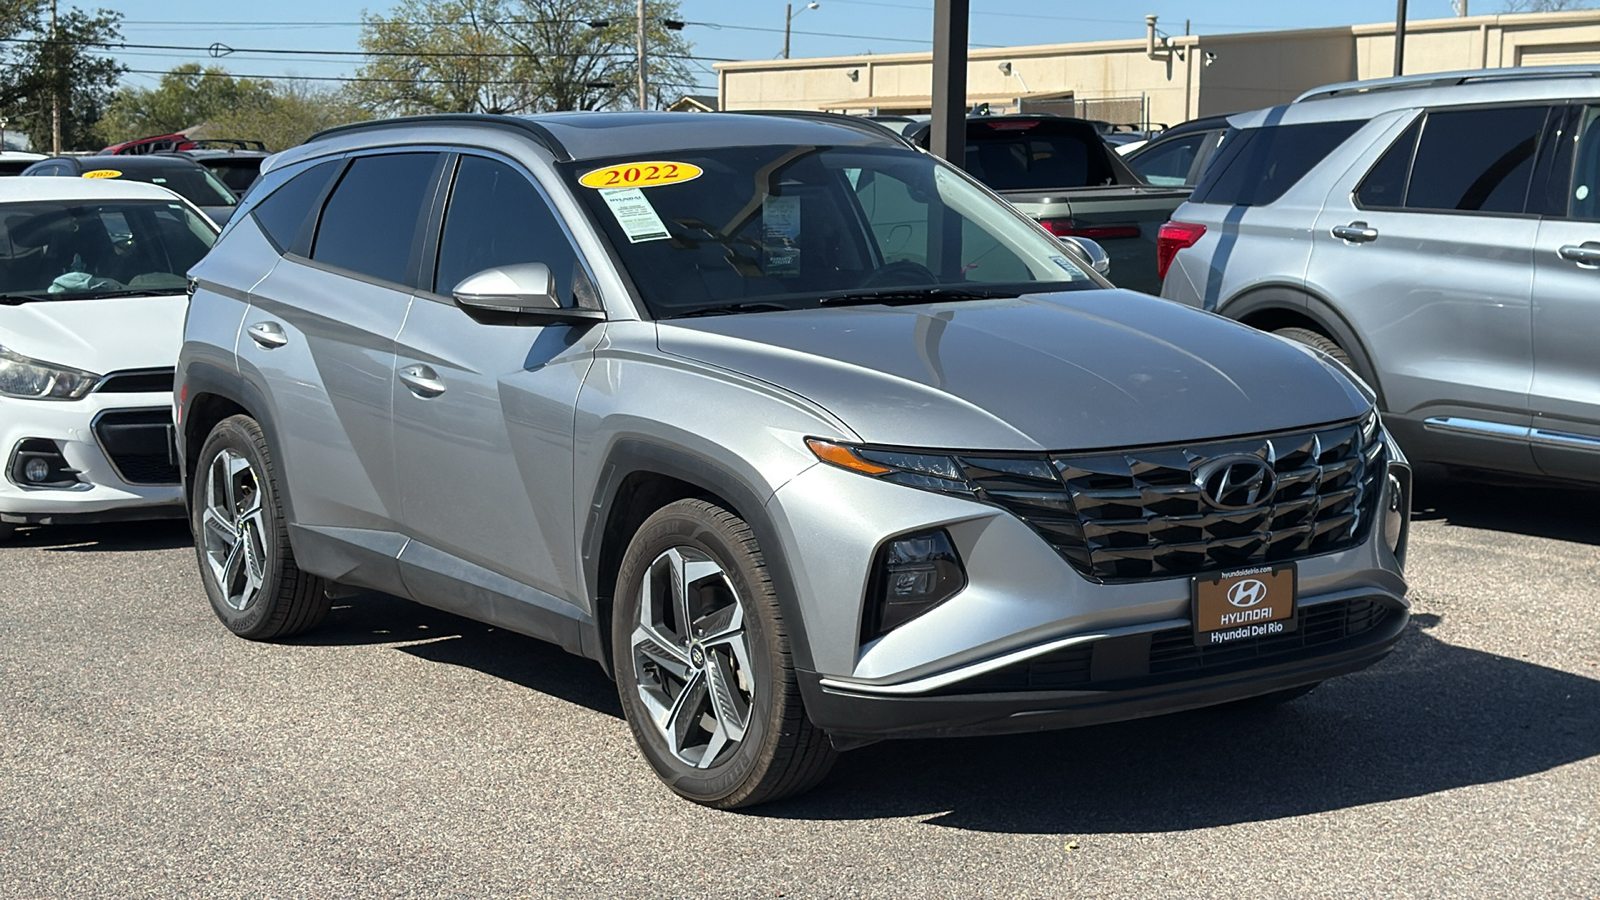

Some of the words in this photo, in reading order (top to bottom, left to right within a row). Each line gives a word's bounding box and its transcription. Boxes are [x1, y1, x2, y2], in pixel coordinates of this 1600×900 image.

[90, 171, 115, 179] 2026
[604, 164, 680, 186] 2022
[1221, 566, 1272, 579] hyundaidelrio.com
[1220, 607, 1273, 625] HYUNDAI
[1211, 626, 1251, 643] Hyundai
[1251, 625, 1267, 637] Del
[1268, 622, 1283, 633] Rio
